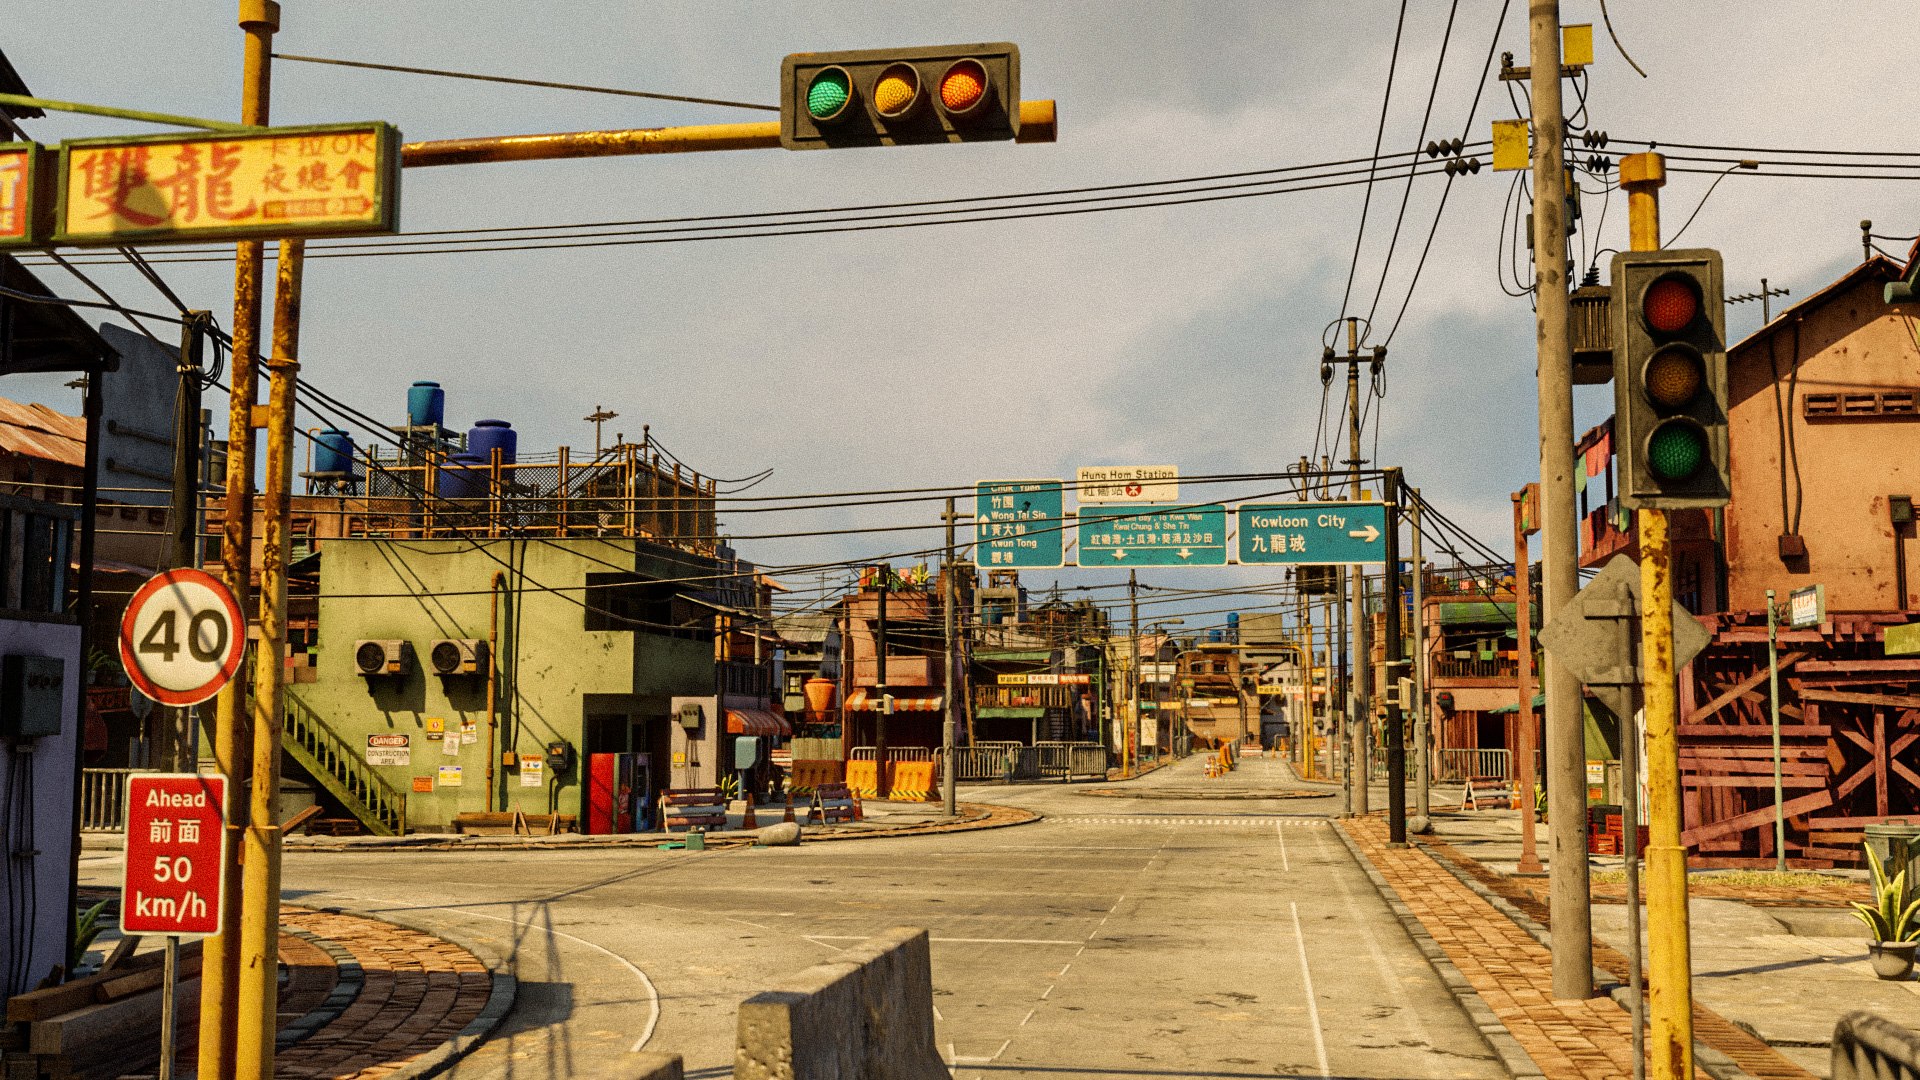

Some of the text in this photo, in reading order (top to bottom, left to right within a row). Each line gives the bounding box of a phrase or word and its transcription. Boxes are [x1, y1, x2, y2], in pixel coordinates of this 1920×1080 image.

[79, 144, 258, 226] 雙龍
[262, 160, 375, 193] 夜總會
[1081, 469, 1174, 481] Hung Hom Station
[991, 510, 1047, 522] Wong Tai Sin
[1251, 513, 1346, 529] Kowloon City
[991, 538, 1037, 549] Kwun Tong
[1251, 533, 1306, 554] 九龍城
[139, 608, 228, 663] 40
[373, 737, 404, 745] DANGER
[145, 788, 206, 808] Ahead
[149, 817, 201, 844] 前面
[153, 855, 192, 883] 50
[135, 889, 207, 924] km/h
